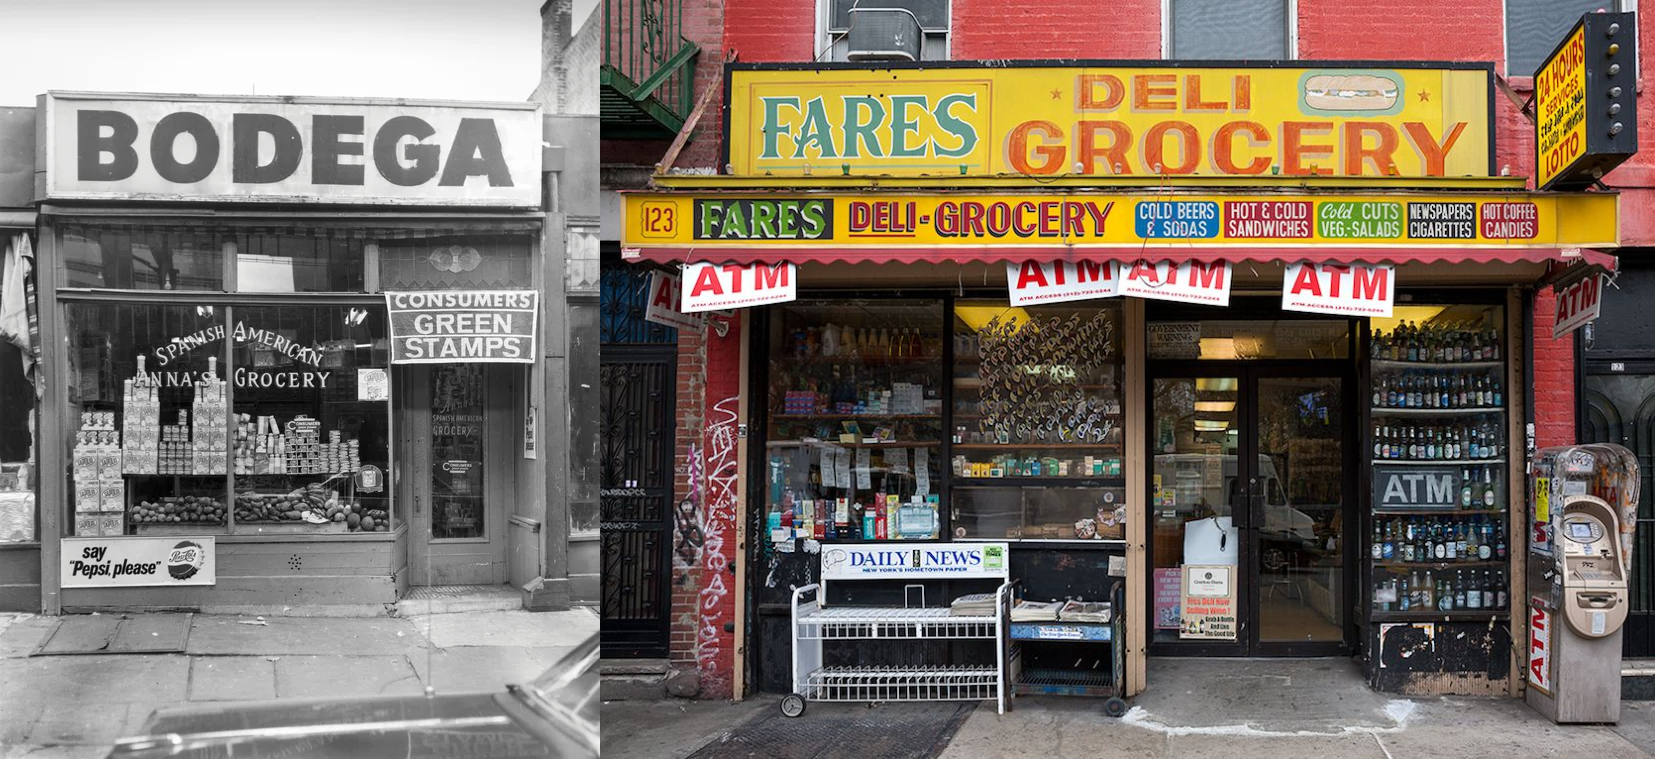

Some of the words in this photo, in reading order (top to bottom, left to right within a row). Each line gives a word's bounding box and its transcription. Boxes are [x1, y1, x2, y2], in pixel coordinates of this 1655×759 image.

[1539, 74, 1550, 106] 24
[1552, 32, 1584, 92] HOURS
[1074, 73, 1251, 115] DELI
[1545, 73, 1579, 118] SERVICES
[758, 92, 979, 160] FARES
[76, 108, 515, 188] BODEGA
[1002, 119, 1468, 176] GROCERY
[1546, 130, 1579, 179] LOTTO
[645, 207, 674, 233] 123
[700, 200, 827, 239] FARES
[1139, 202, 1173, 220] COLD
[1177, 202, 1215, 220] BEERS
[1231, 202, 1257, 219] HOT
[1261, 202, 1270, 219] &
[1275, 202, 1307, 219] COLD
[1321, 202, 1354, 220] Cold
[1361, 202, 1399, 220] CUTS
[1410, 203, 1473, 220] NEWSPAPERS
[1482, 203, 1502, 220] HOT
[1505, 203, 1536, 220] COFFEE
[1147, 221, 1156, 237] &
[1163, 221, 1208, 237] SODAS
[1229, 220, 1309, 237] SANDWICHES
[1410, 221, 1472, 238] CIGARETTES
[1485, 221, 1533, 238] CANDIES
[690, 259, 789, 298] ATM
[1128, 258, 1226, 290] ATM
[1290, 262, 1388, 301] ATM
[395, 292, 531, 308] CONSUMERS
[1555, 273, 1599, 326] ATM
[414, 313, 512, 334] GREEN
[405, 337, 521, 358] STAMPS
[234, 367, 331, 388] GROCERY
[1382, 474, 1453, 503] ATM
[82, 546, 107, 562] say
[851, 551, 909, 566] DAILY
[925, 550, 981, 566] NEWS
[1531, 597, 1545, 686] ATM
